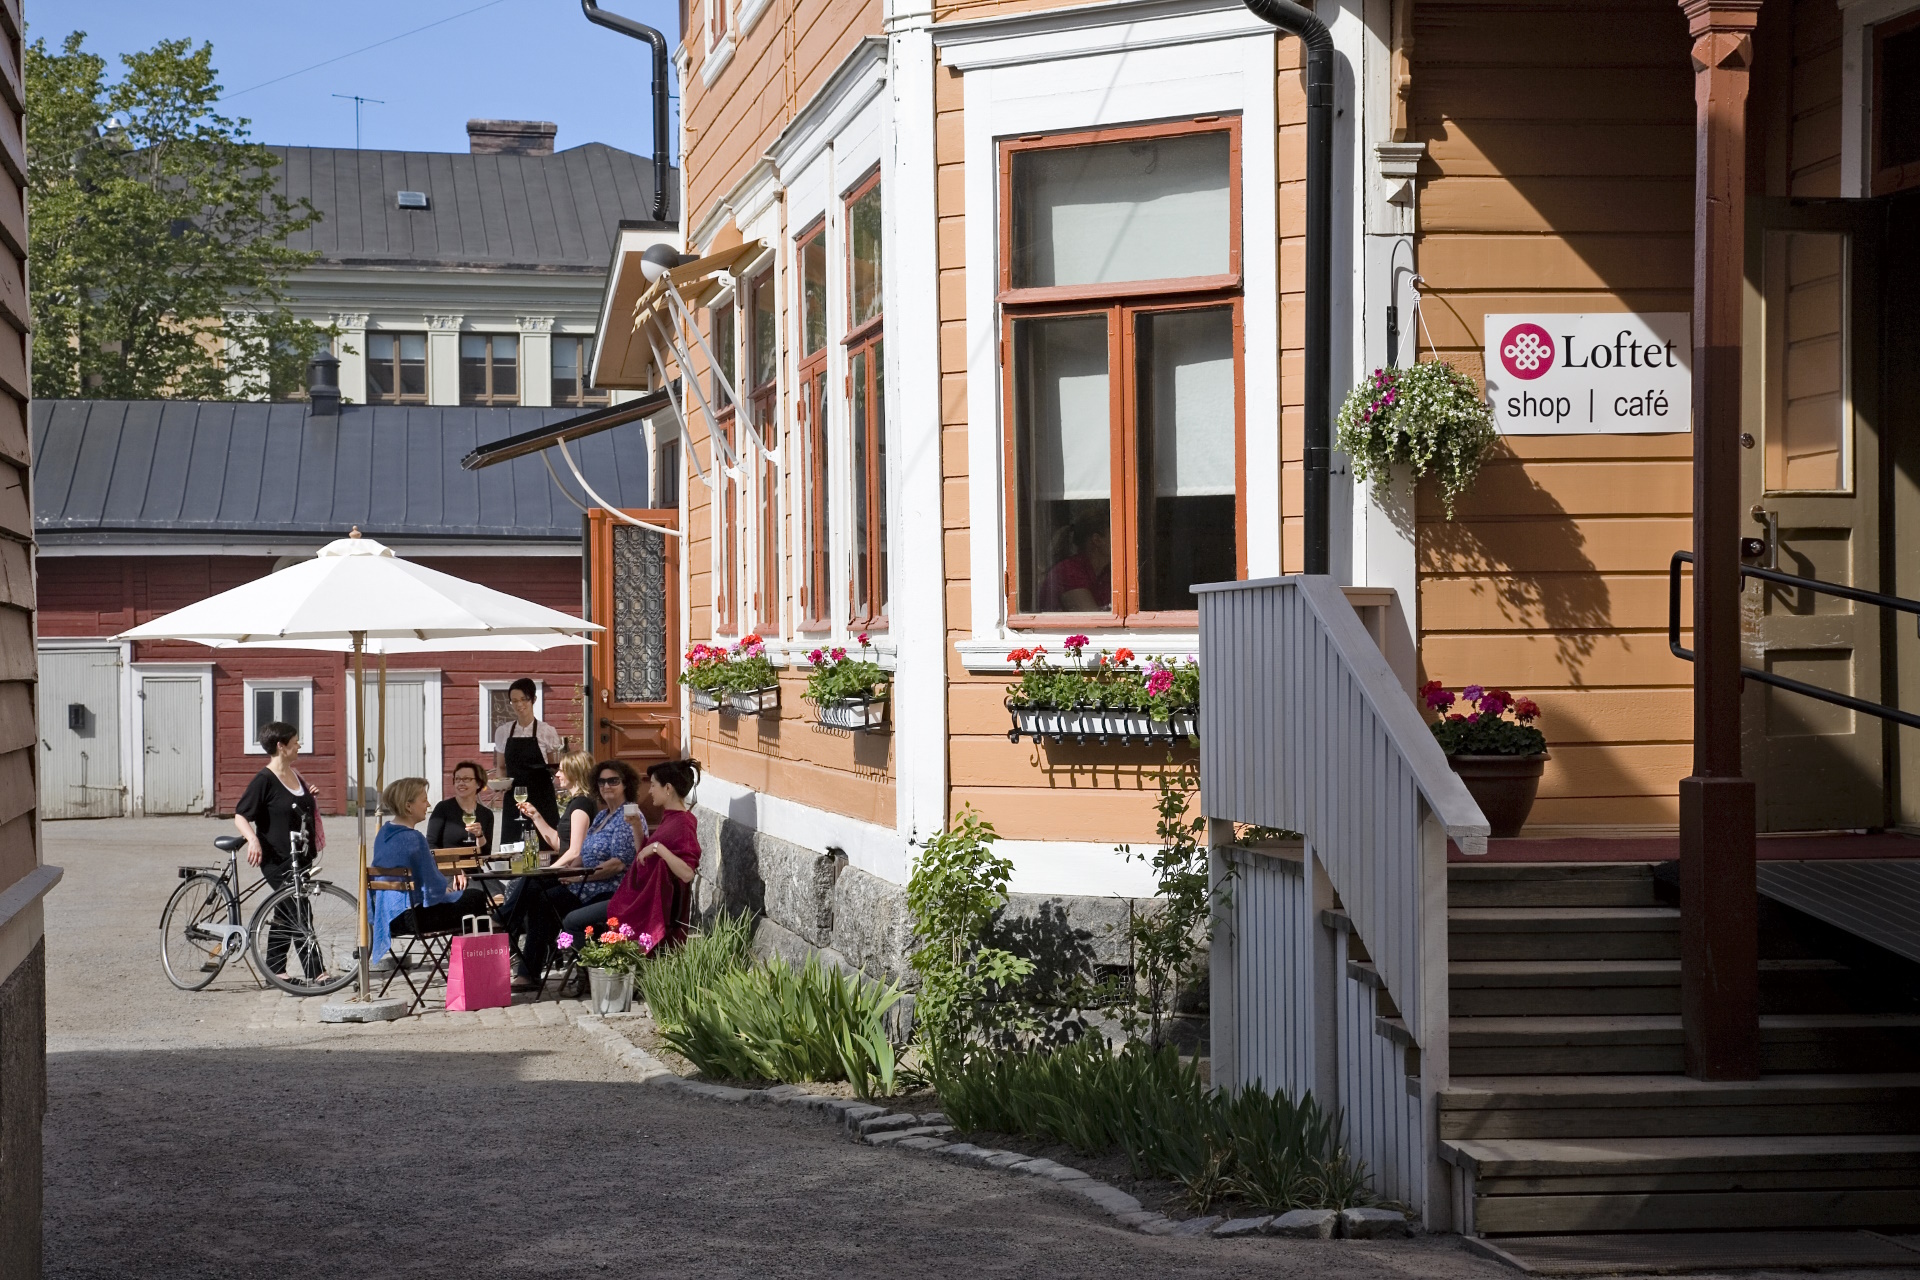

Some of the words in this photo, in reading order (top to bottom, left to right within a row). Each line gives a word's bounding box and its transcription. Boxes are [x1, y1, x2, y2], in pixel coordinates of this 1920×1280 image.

[1561, 329, 1677, 368] Loftet
[1507, 390, 1571, 423] shop
[1614, 389, 1669, 417] café
